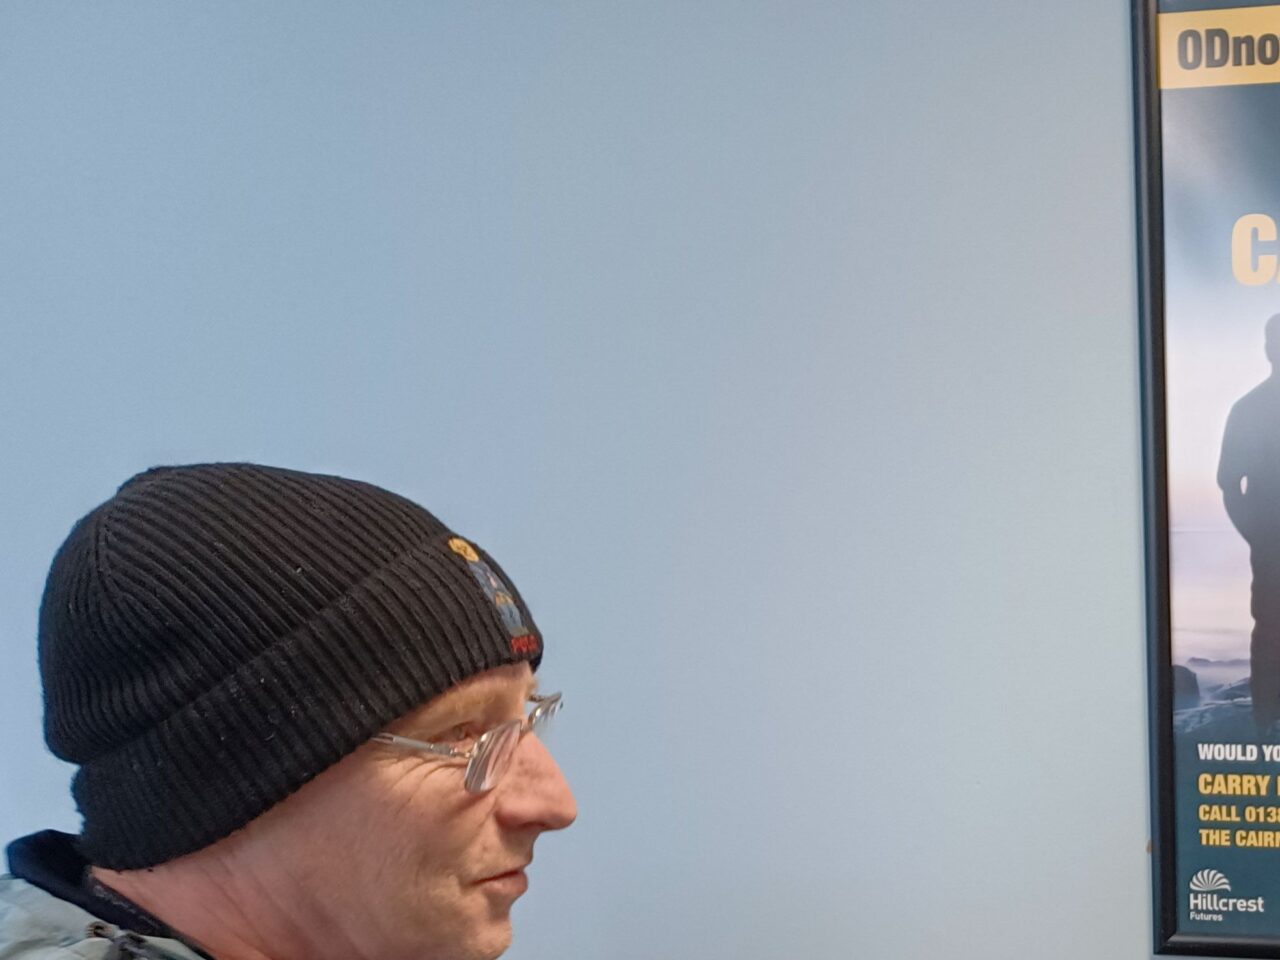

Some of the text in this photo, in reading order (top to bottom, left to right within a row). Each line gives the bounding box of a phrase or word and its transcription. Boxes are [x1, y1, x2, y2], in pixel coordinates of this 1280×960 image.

[1198, 743, 1257, 761] WOULD
[1198, 773, 1271, 796] CARRY
[1198, 804, 1241, 822] CALL
[1199, 829, 1231, 846] THE
[1189, 892, 1265, 913] Hillcrest
[1190, 911, 1223, 921] Futures
